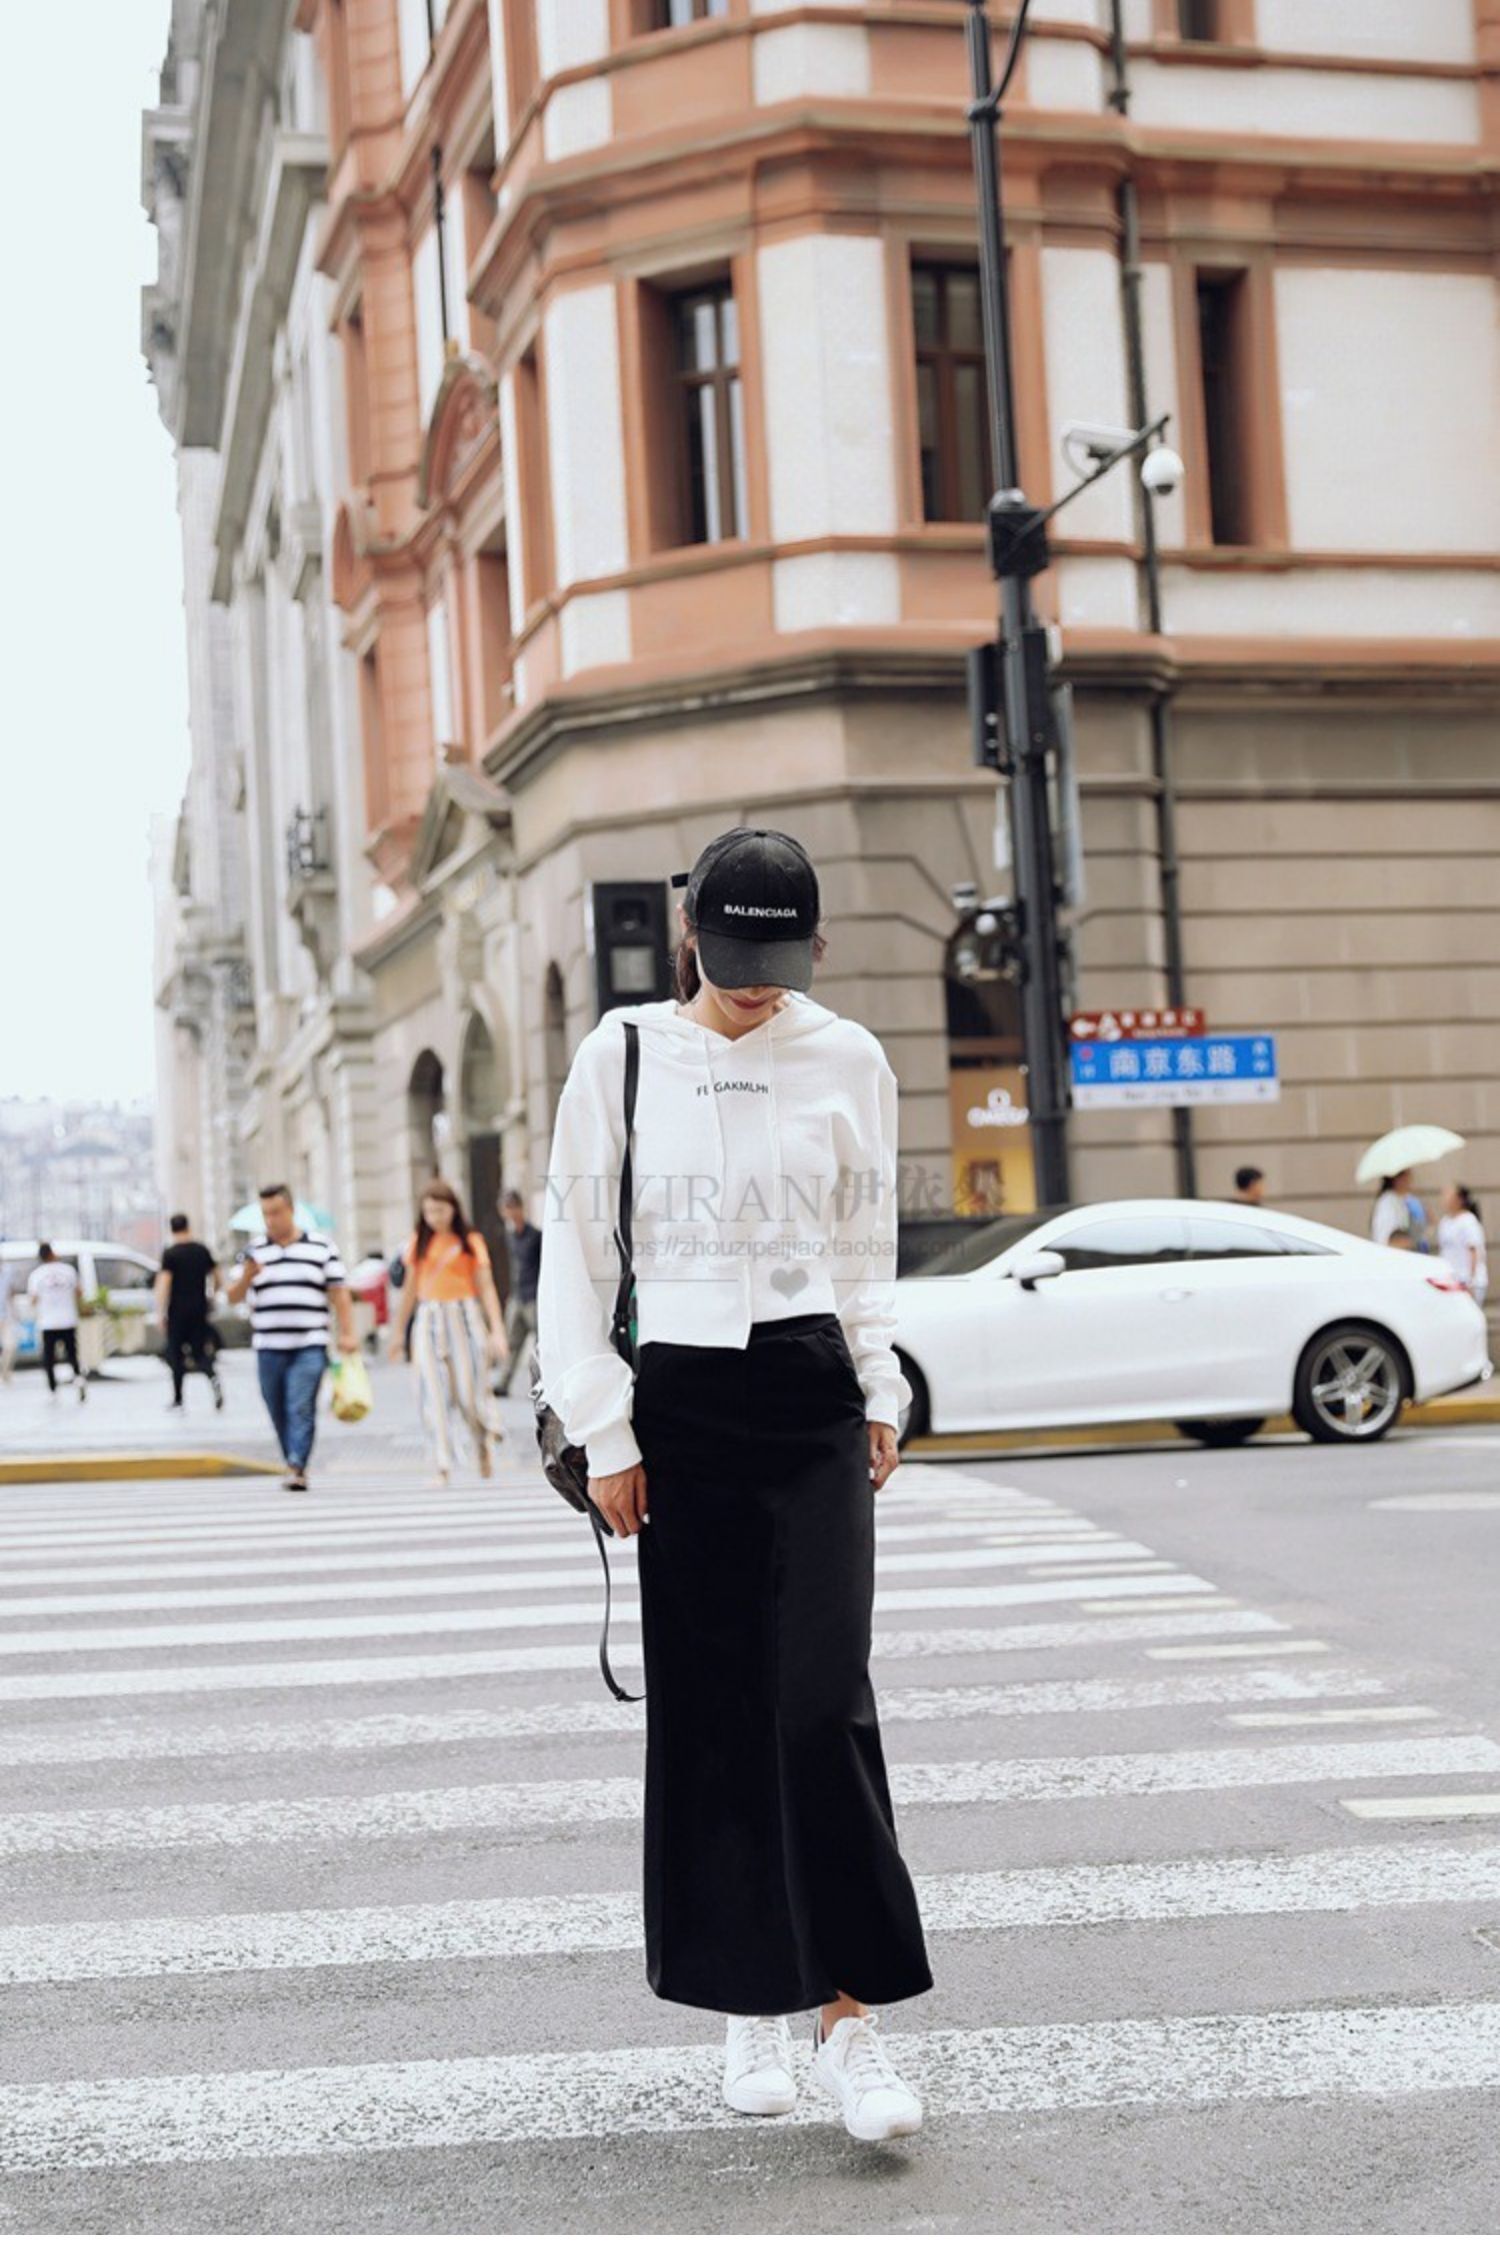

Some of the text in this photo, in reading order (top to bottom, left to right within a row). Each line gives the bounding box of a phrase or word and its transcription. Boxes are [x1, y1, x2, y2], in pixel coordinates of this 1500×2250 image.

[723, 904, 798, 918] BALENCIAGA
[1108, 1045, 1237, 1080] 南京东路
